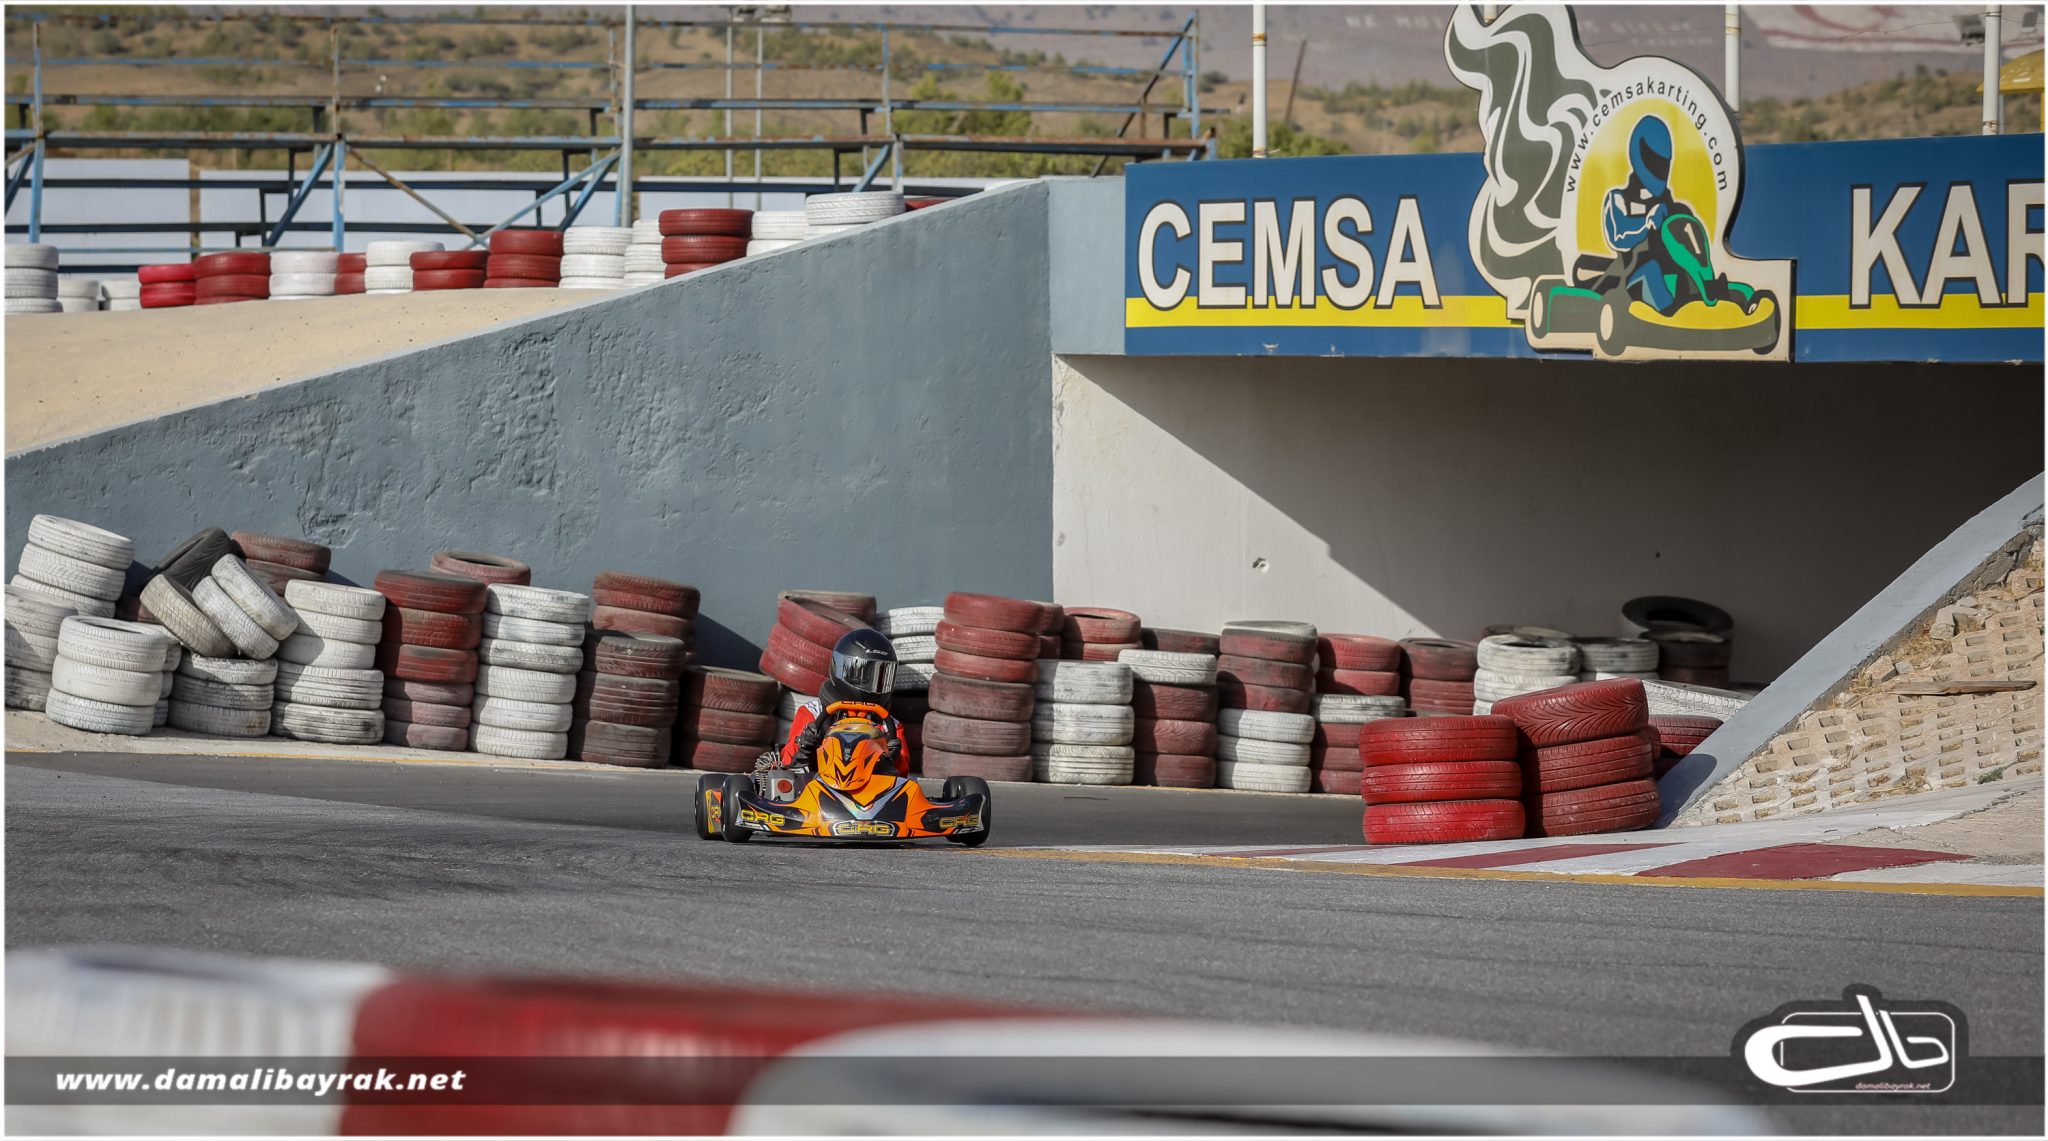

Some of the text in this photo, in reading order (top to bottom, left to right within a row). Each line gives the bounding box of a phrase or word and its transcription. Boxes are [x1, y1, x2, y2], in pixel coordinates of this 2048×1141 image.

[1566, 75, 1727, 193] www.cemsakarting.com
[1137, 194, 1443, 311] CEMSA
[1850, 178, 2045, 309] KAR
[740, 809, 786, 827] CRG
[837, 822, 891, 836] CRG
[938, 814, 980, 830] CRG
